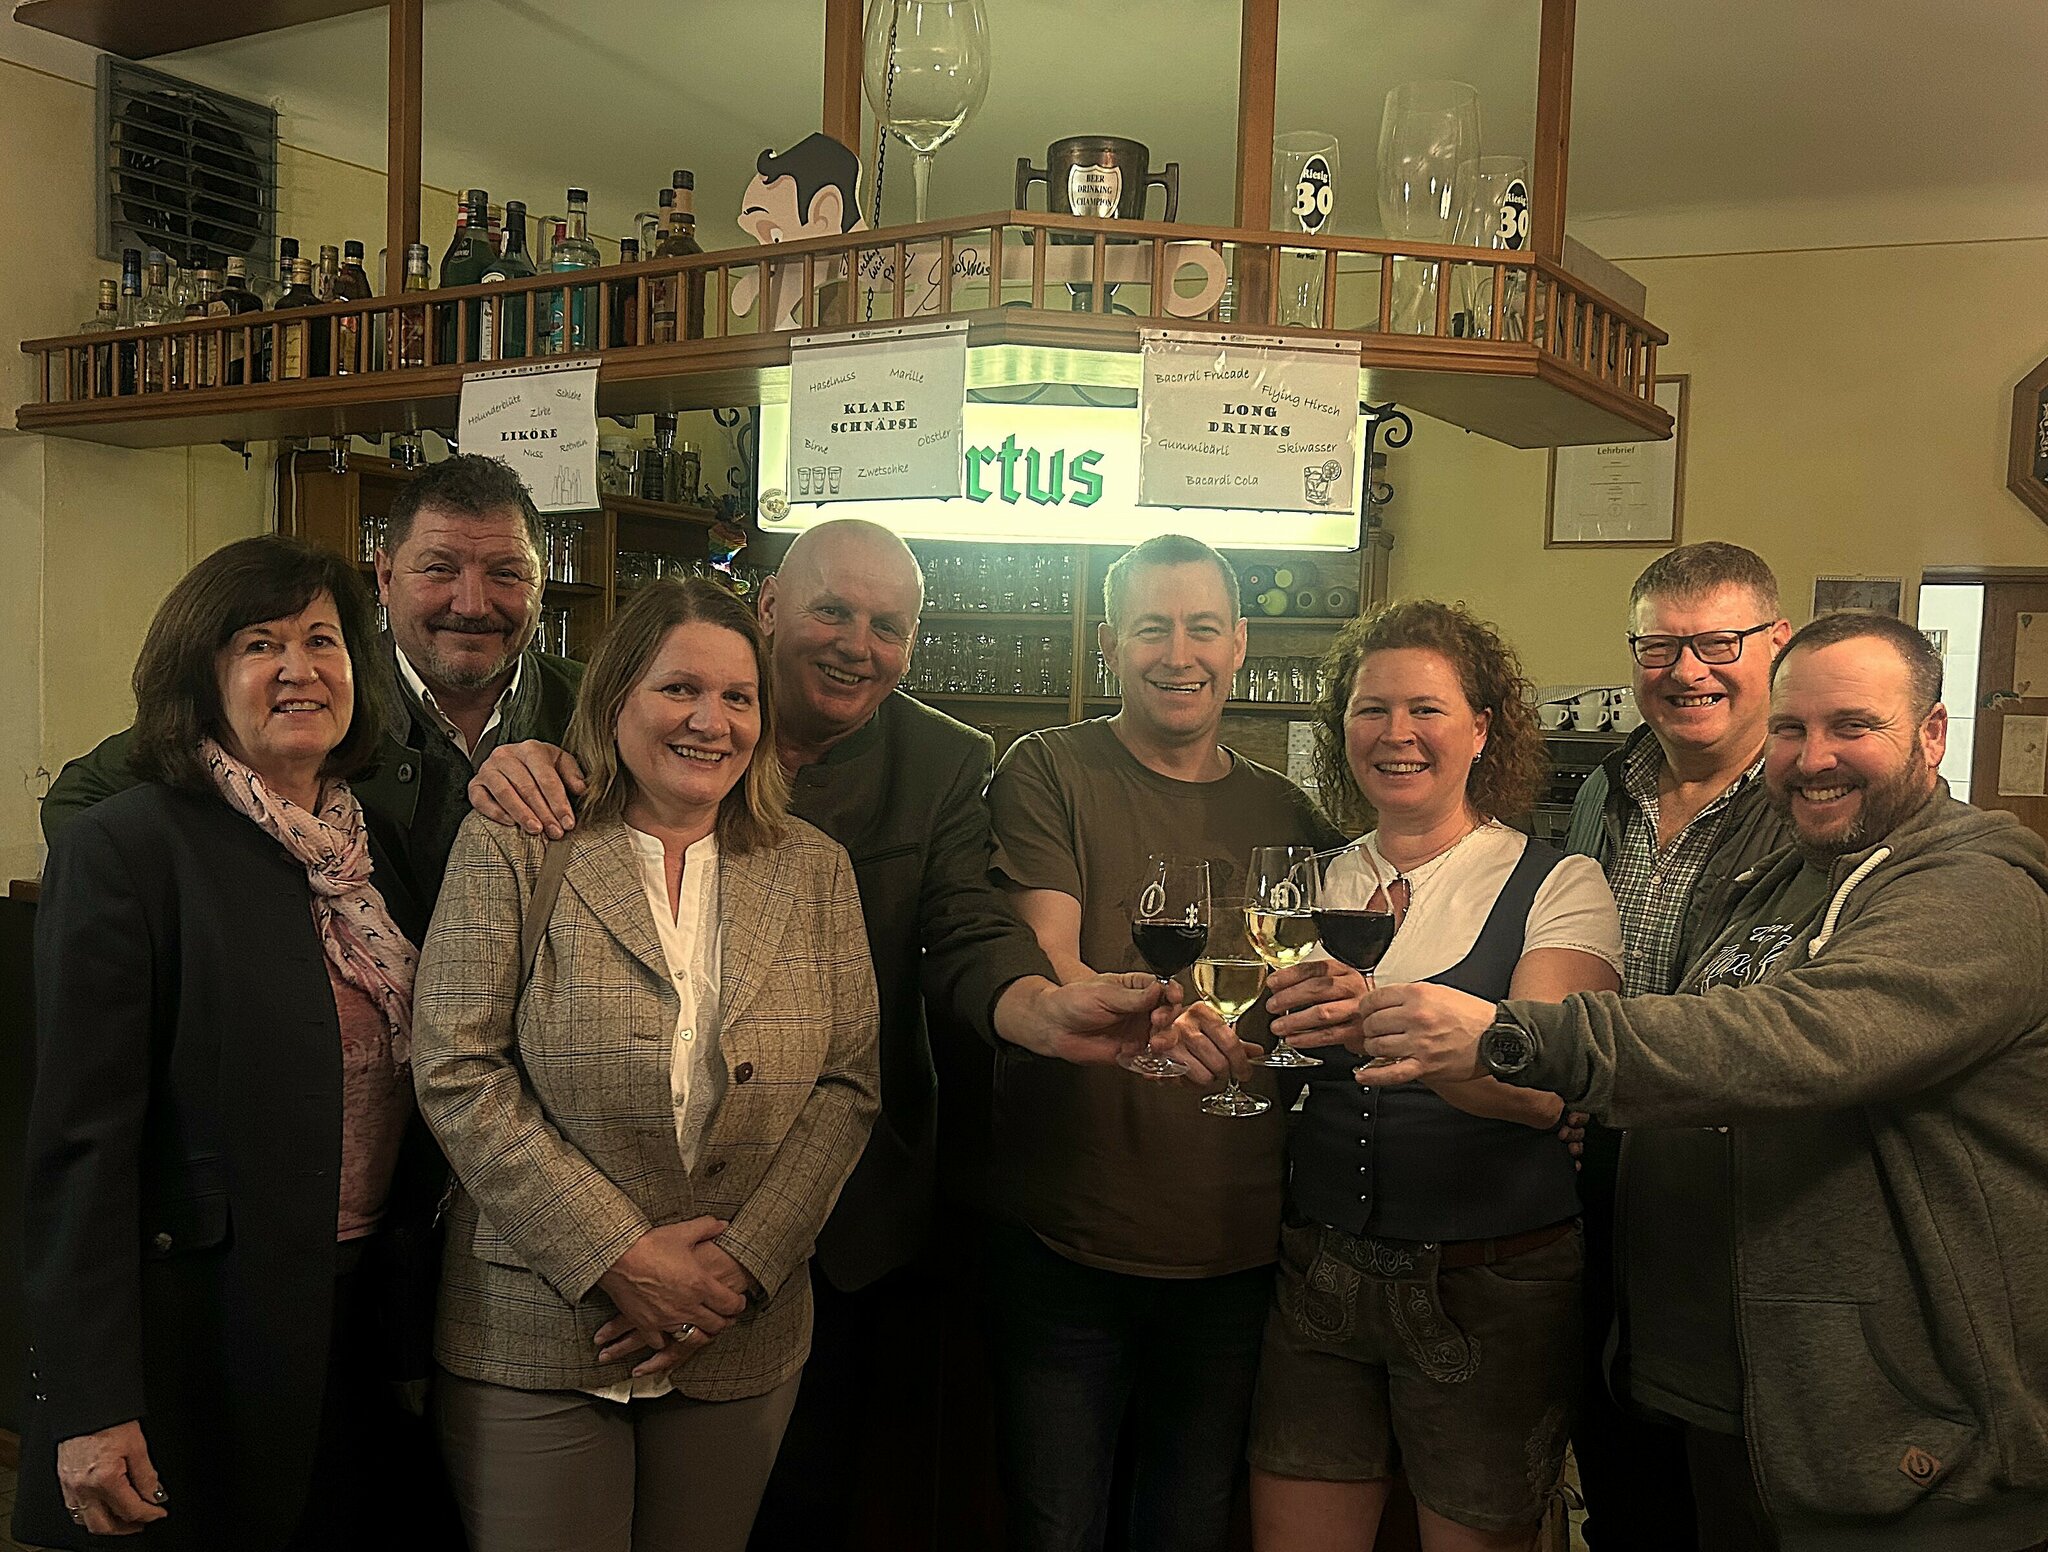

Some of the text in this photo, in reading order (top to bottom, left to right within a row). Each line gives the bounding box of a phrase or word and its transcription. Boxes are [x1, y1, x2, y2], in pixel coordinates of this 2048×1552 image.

[1086, 174, 1105, 183] BEER
[1077, 185, 1113, 194] DRINKING
[1076, 197, 1112, 207] CHAMPION
[1292, 182, 1333, 216] 30
[1496, 205, 1529, 239] 30
[808, 371, 857, 393] Haselnuss
[889, 367, 924, 384] Marille
[1154, 368, 1250, 384] Bacardi Frucade
[843, 400, 906, 415] KLARE
[1261, 384, 1341, 417] Flying Hirsch
[1223, 403, 1278, 418] LONG
[830, 417, 918, 433] SCHNÄPSE
[1207, 421, 1292, 437] DRINKS
[500, 428, 558, 441] LIKÖRE
[917, 429, 952, 447] Obstler
[523, 449, 544, 459] Nuss
[804, 438, 829, 455] Birne
[1158, 438, 1230, 456] Gummibärli
[1276, 442, 1338, 454] Skiwasser
[1597, 446, 1636, 455] Lehrbrief
[857, 463, 909, 478] Zwetschke
[1185, 475, 1259, 486] Bacardi Cola
